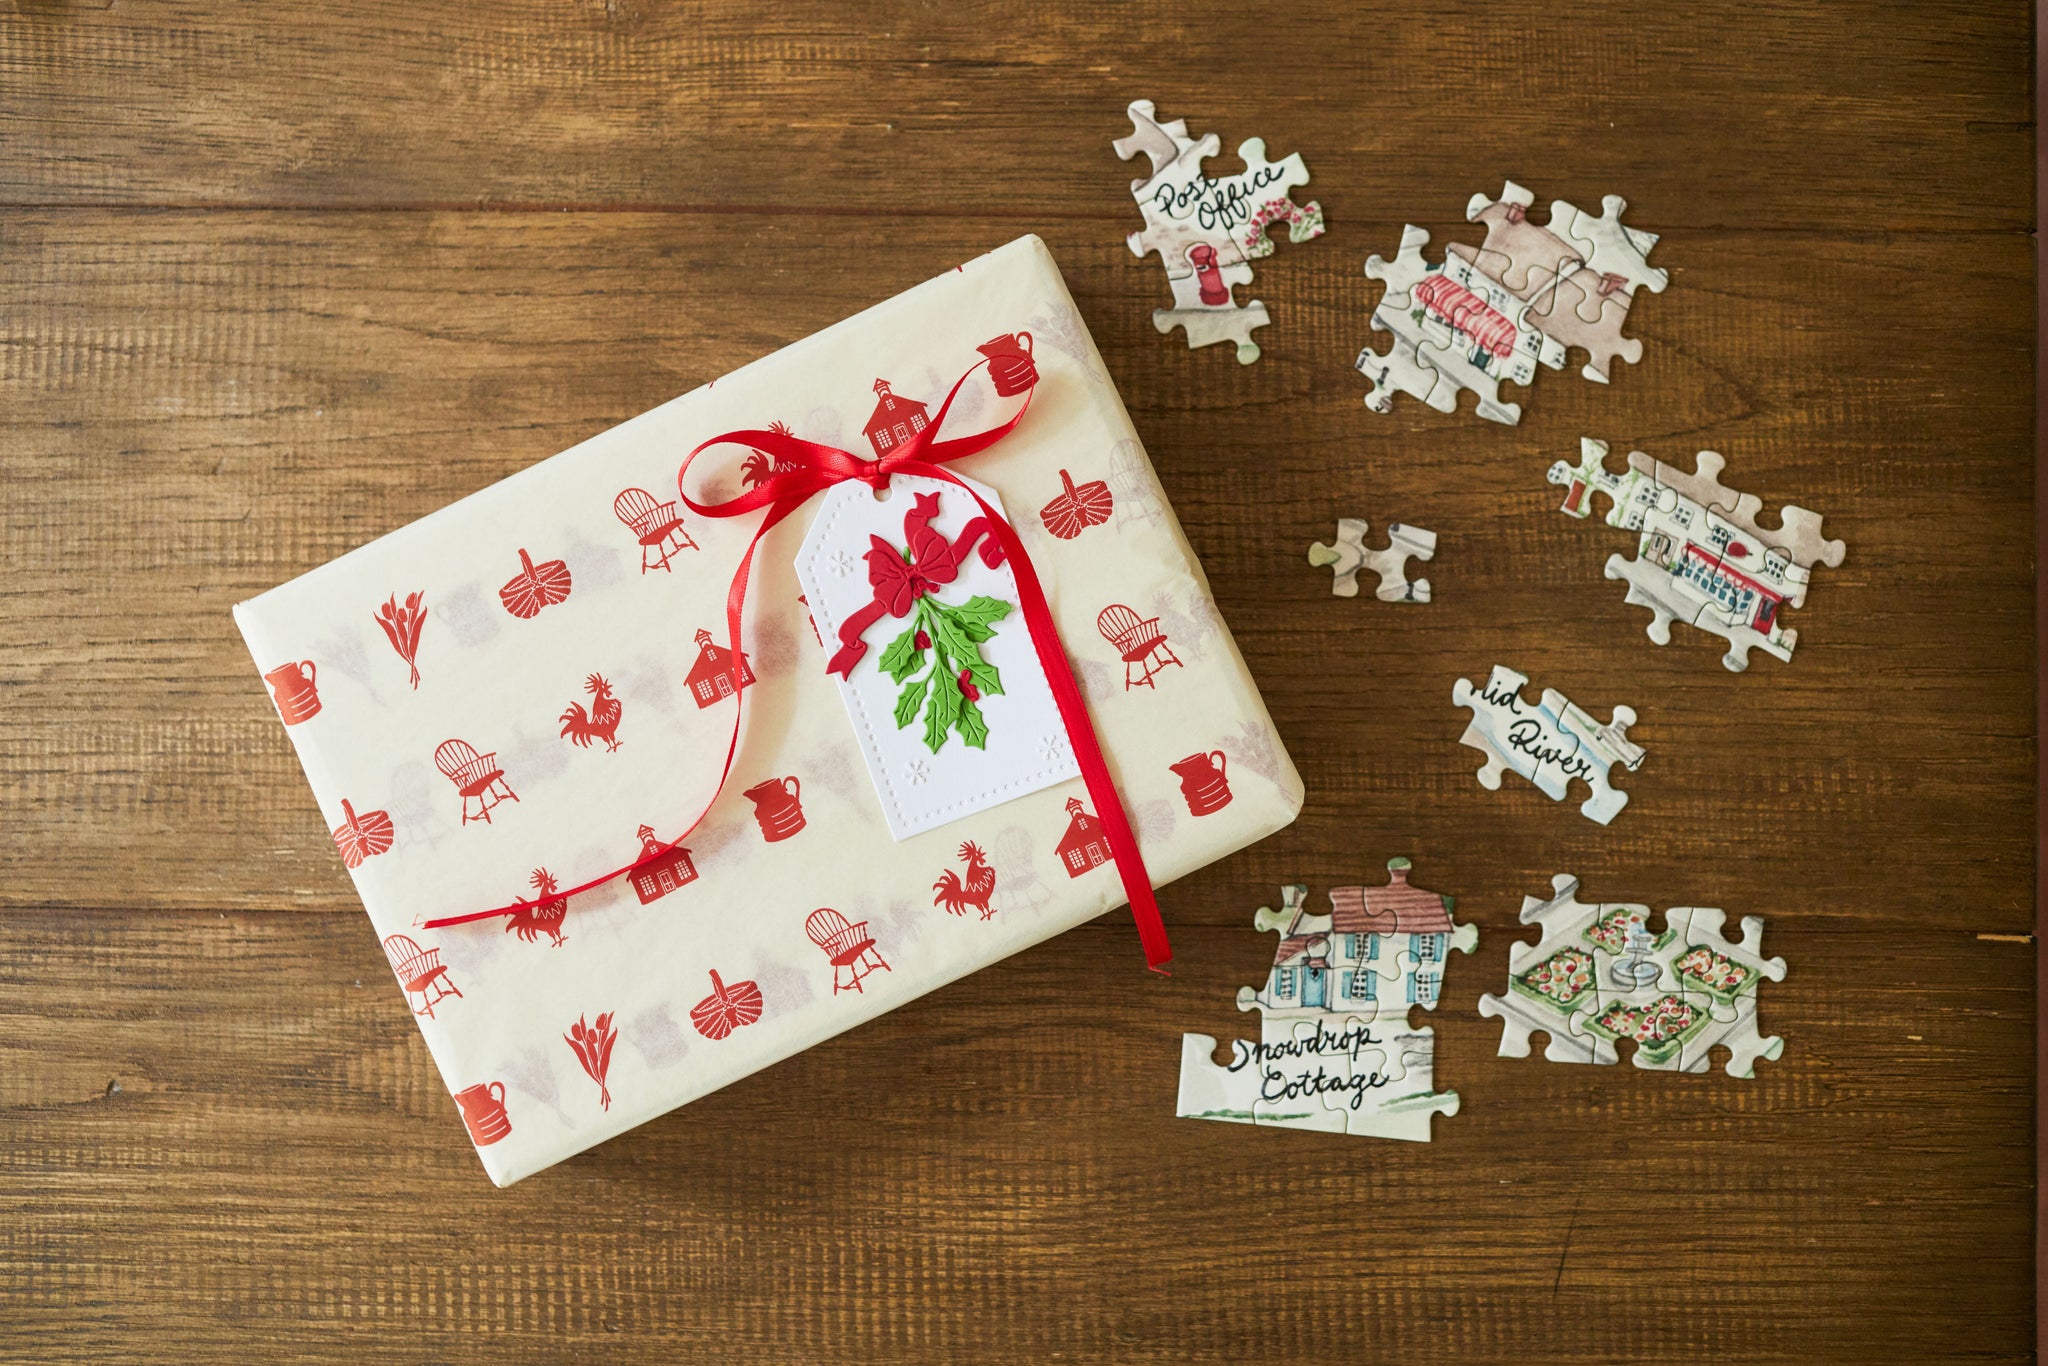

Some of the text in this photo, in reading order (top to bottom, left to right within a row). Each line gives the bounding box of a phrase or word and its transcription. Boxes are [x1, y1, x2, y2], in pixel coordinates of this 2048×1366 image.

[1154, 173, 1220, 218] Post
[1198, 167, 1285, 230] Office
[1508, 719, 1594, 782] River
[1261, 1065, 1390, 1110] Cottage
